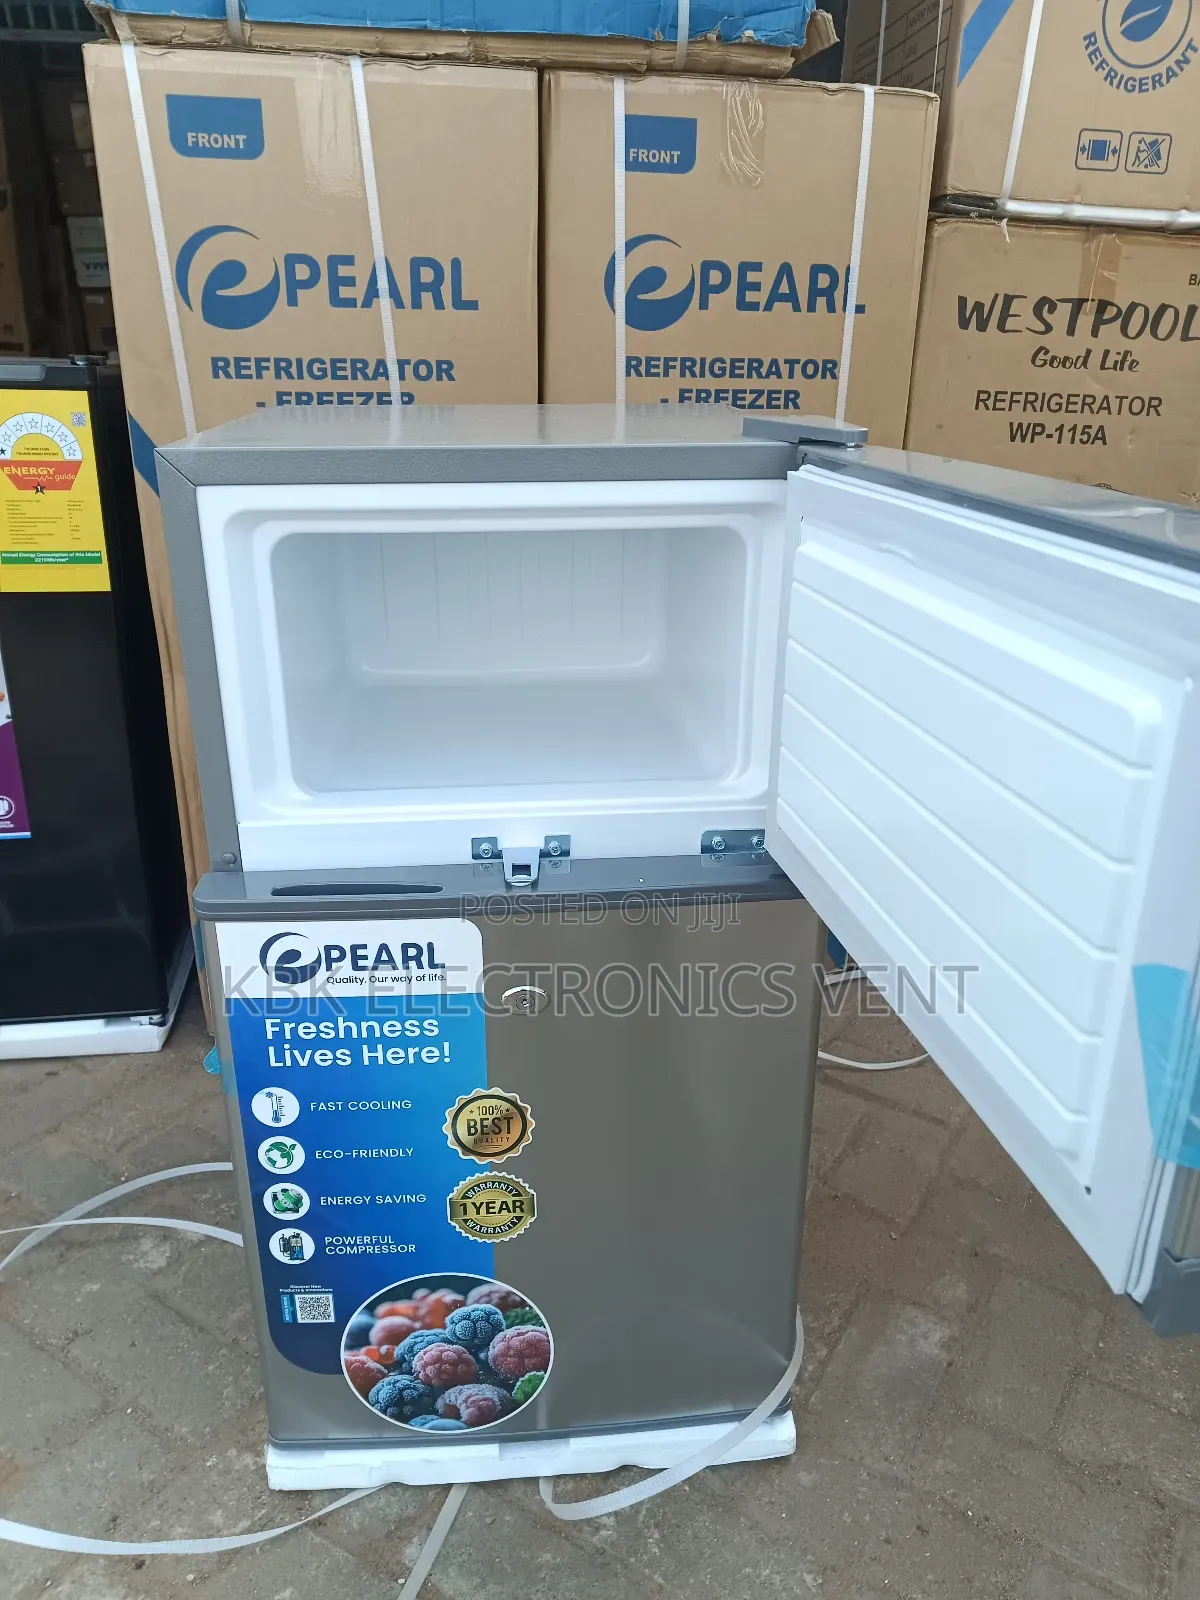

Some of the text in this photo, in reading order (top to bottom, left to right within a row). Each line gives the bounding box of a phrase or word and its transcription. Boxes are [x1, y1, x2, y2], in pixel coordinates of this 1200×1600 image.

[1083, 30, 1199, 94] REFRIGERANT
[187, 132, 247, 149] FRONT
[629, 148, 681, 164] FRONT
[284, 253, 479, 311] PEARL
[1188, 273, 1200, 286] B
[957, 293, 1200, 343] WESTPOOL
[625, 356, 839, 380] REFRIGERATOR
[1030, 346, 1140, 373] Good Life
[210, 356, 456, 382] REFRIGERATOR
[974, 389, 1163, 417] REFRIGERATOR
[1008, 421, 1108, 445] WP-115A
[3, 465, 56, 476] ENERGY
[55, 473, 76, 481] guide
[324, 941, 446, 972] PEARL
[326, 973, 447, 985] Quality. Our way of life.
[264, 1016, 440, 1040] Freshness
[268, 1041, 451, 1067] Lives Here!
[310, 1100, 412, 1112] FAST COOLING
[477, 1104, 504, 1117] 100%
[466, 1116, 514, 1137] BEST
[473, 1136, 510, 1145] QUALITY
[315, 1148, 414, 1160] ECO-FRIENDLY
[465, 1181, 519, 1198] WARRANTY
[320, 1193, 427, 1206] ENERGY SAVING
[471, 1199, 525, 1215] YEAR
[466, 1216, 519, 1234] WARRANTY
[324, 1235, 395, 1246] POWERFUL
[325, 1244, 416, 1255] COMPRESSOR
